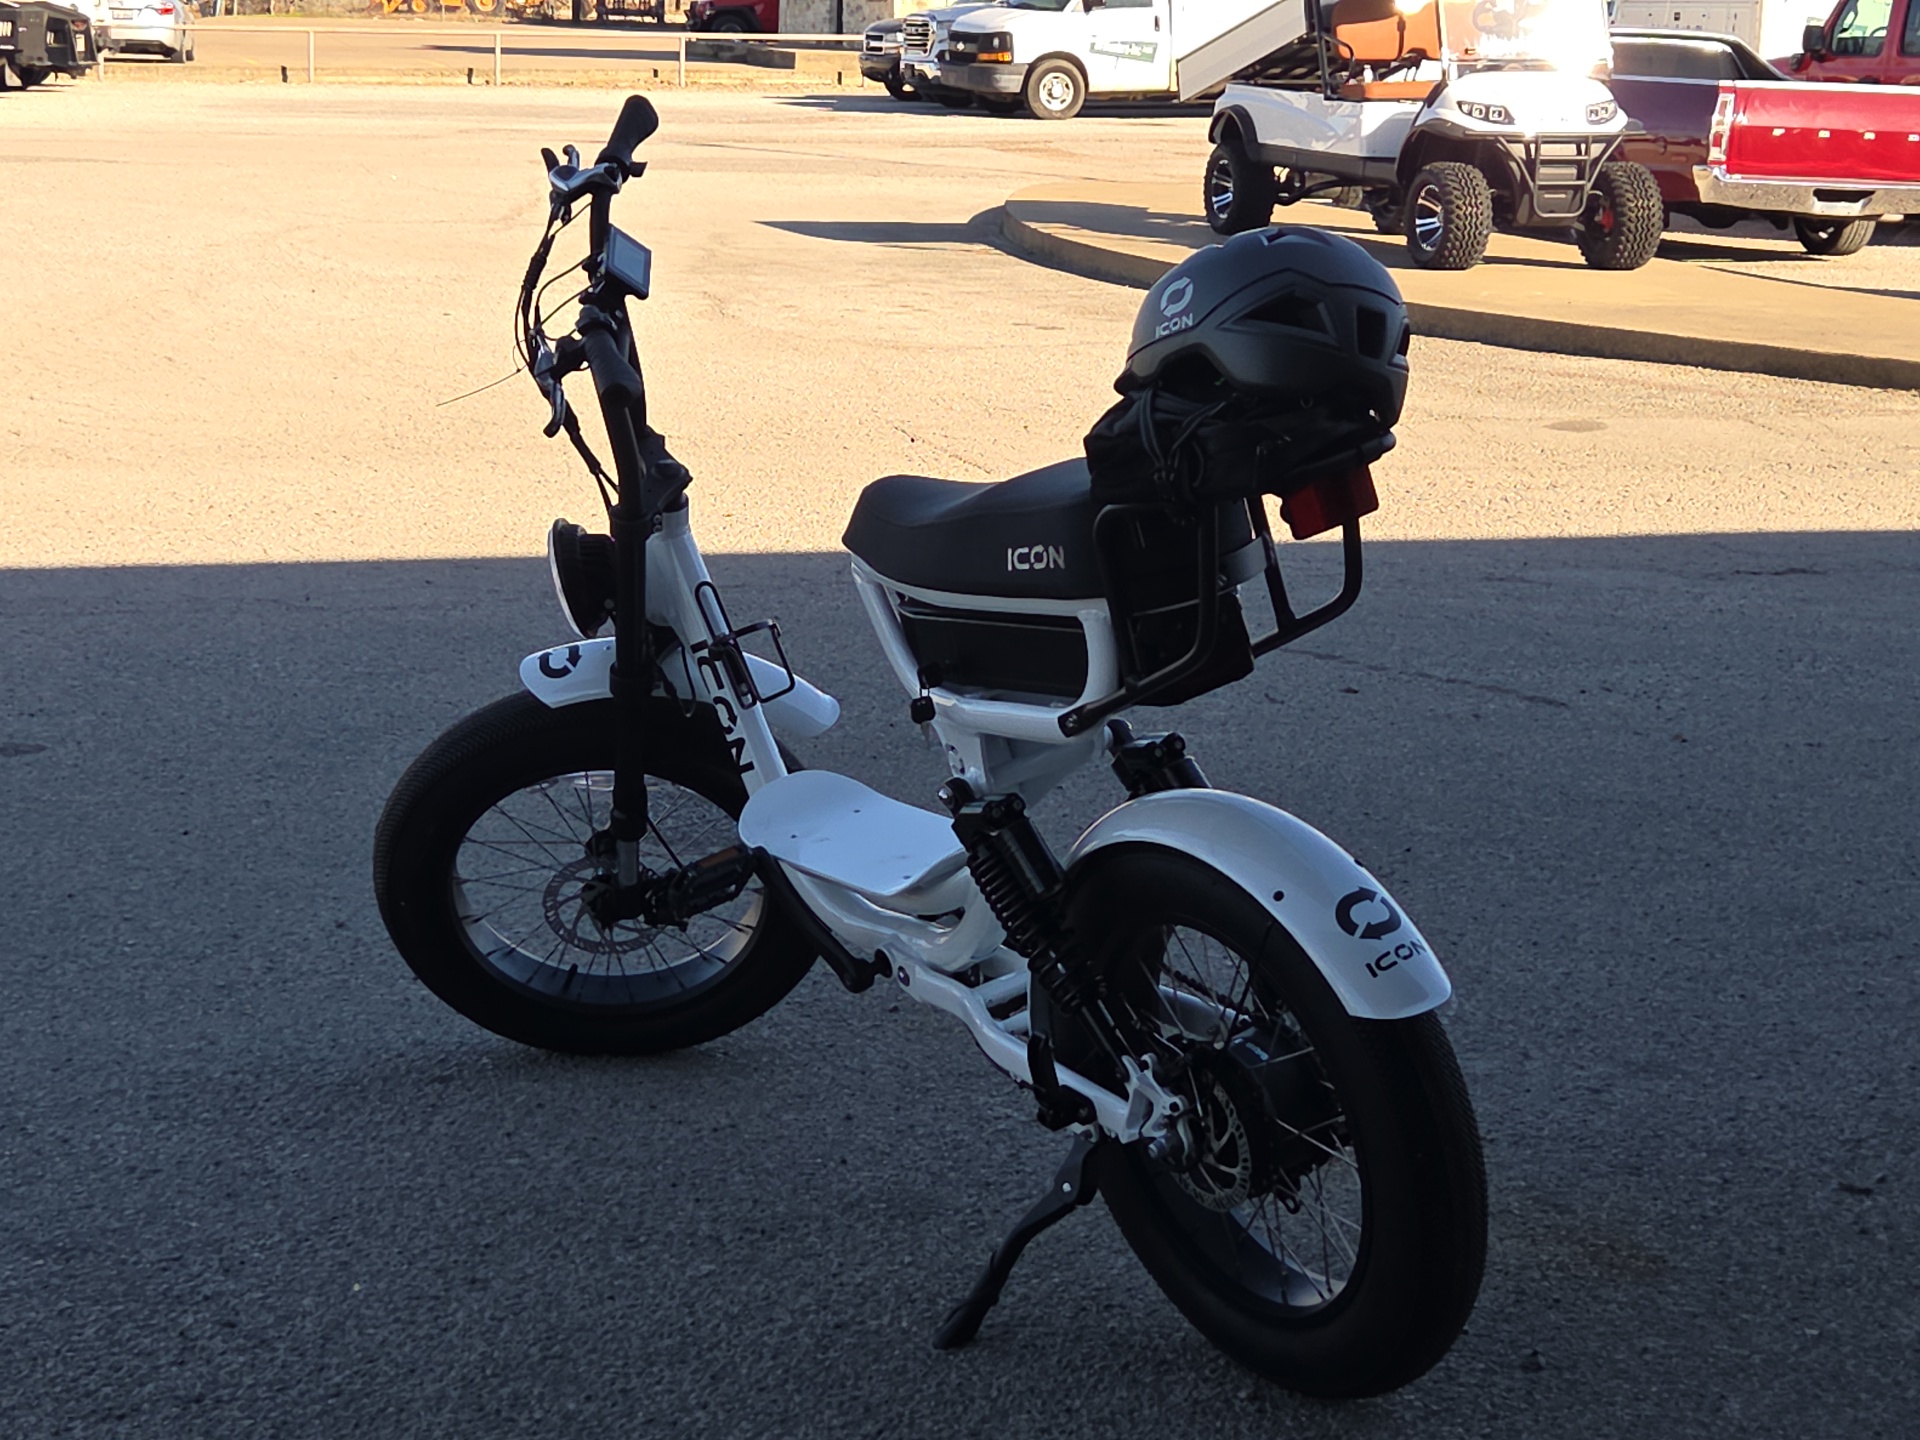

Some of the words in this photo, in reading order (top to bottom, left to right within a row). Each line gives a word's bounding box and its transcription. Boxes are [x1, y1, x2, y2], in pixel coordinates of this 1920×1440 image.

[1155, 313, 1194, 339] ICON
[1007, 544, 1065, 571] ICON
[1365, 938, 1427, 978] ICON
